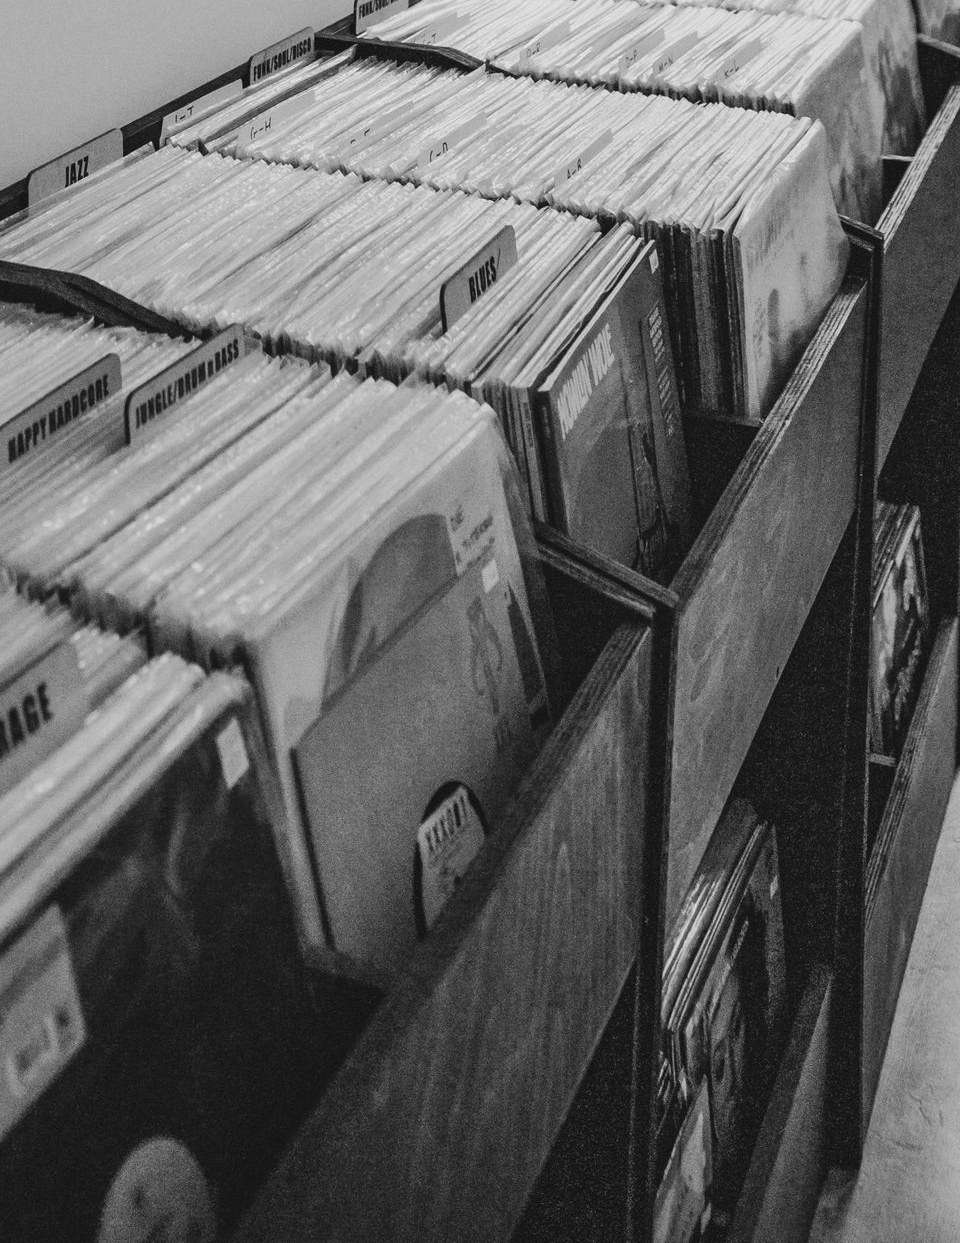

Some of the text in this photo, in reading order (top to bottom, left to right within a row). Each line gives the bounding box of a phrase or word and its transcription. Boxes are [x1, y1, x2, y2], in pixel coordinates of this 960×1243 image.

[253, 37, 312, 82] FUNK/SOUL/DISCO
[65, 155, 90, 188] JAZZ
[468, 255, 497, 304] BLUES
[215, 338, 239, 373] BASS
[588, 322, 615, 387] WOLF
[7, 373, 110, 464] HAPPY HARDCORE
